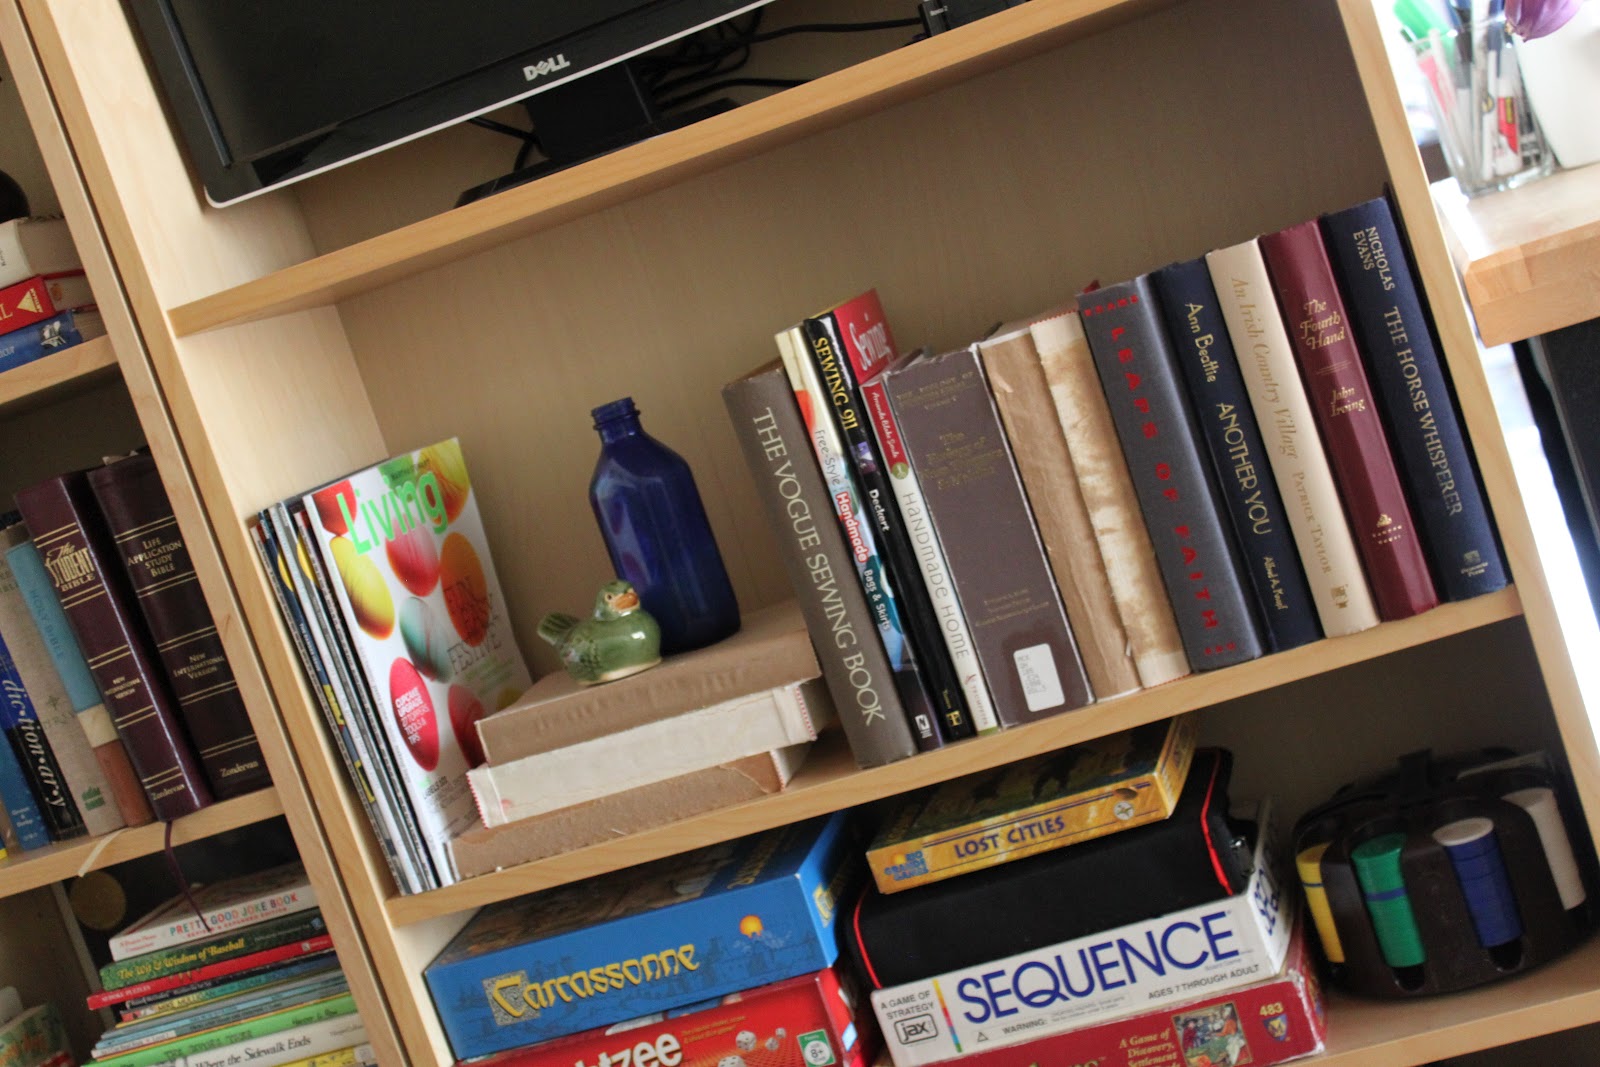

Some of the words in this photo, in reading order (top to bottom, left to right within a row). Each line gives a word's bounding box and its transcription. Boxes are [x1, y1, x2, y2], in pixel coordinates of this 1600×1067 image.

[523, 54, 571, 81] DELL
[1352, 230, 1375, 272] EVANS
[1365, 226, 1396, 291] NICHOLAS
[1231, 277, 1248, 302] An
[1239, 304, 1264, 338] Irish
[1304, 299, 1328, 316] The
[1300, 314, 1342, 340] Fourth
[1306, 328, 1346, 351] Hand
[1185, 302, 1203, 334] Ann
[1195, 334, 1220, 383] Beattie
[813, 337, 850, 407] SEWING
[839, 408, 859, 431] 911
[1254, 343, 1280, 403] Country
[871, 391, 887, 421] Amanda
[1331, 385, 1356, 406] John
[1331, 397, 1367, 418] Irving
[1383, 306, 1409, 347] THE
[1396, 349, 1430, 413] HORSE
[1417, 410, 1463, 517] WHISPERER
[1274, 408, 1297, 460] Village
[814, 429, 841, 486] Free-Style
[1216, 402, 1258, 492] ANOTHER
[1245, 490, 1272, 535] YOU
[1110, 327, 1159, 440] LEAPS
[1155, 462, 1179, 501] OF
[1173, 525, 1218, 631] FAITH
[336, 471, 449, 555] Living
[868, 488, 890, 532] Deckert
[1292, 472, 1316, 522] PATRICK
[1310, 523, 1332, 576] TAYLOR
[835, 492, 869, 563] Handmade
[46, 541, 76, 561] The
[127, 541, 183, 567] APPLICATION
[143, 537, 162, 550] LIFE
[45, 547, 95, 588] STUDENT
[145, 554, 174, 570] STUDY
[150, 563, 176, 578] BIBLE
[752, 406, 788, 462] THE
[770, 457, 823, 551] VOGUE
[804, 553, 858, 651] SEWING
[843, 650, 888, 727] BOOK
[61, 572, 97, 592] BIBLE
[862, 569, 877, 594] Bags
[871, 593, 882, 603] &
[875, 602, 891, 631] Skirts
[219, 760, 259, 778] Zondervan
[151, 784, 186, 800] Zondervan
[954, 834, 1000, 859] LOST
[1007, 815, 1066, 844] CITIES
[210, 909, 239, 925] GOOD
[242, 900, 268, 917] JOKE
[269, 891, 298, 909] BOOK
[163, 952, 197, 967] Wisdom
[197, 947, 208, 962] of
[206, 937, 245, 956] Baseball
[492, 942, 700, 1019] Carcassonne
[956, 910, 1241, 1025] SEQUENCE
[1148, 987, 1174, 1000] AGES
[1174, 984, 1181, 993] 7
[1182, 973, 1228, 992] THROUGH
[1230, 964, 1260, 978] ADULT
[880, 1002, 888, 1011] A
[888, 993, 919, 1009] GAME
[919, 990, 932, 1000] OF
[886, 1001, 935, 1021] STRATEGY
[1258, 1001, 1285, 1018] 483
[900, 1020, 929, 1042] jax
[1002, 1018, 1049, 1035] WARNING:
[1119, 1038, 1128, 1049] A
[1130, 1033, 1158, 1046] Game
[1159, 1028, 1171, 1041] of
[228, 1053, 242, 1066] the
[244, 1040, 286, 1062] Sidewalk
[287, 1034, 312, 1050] Ends
